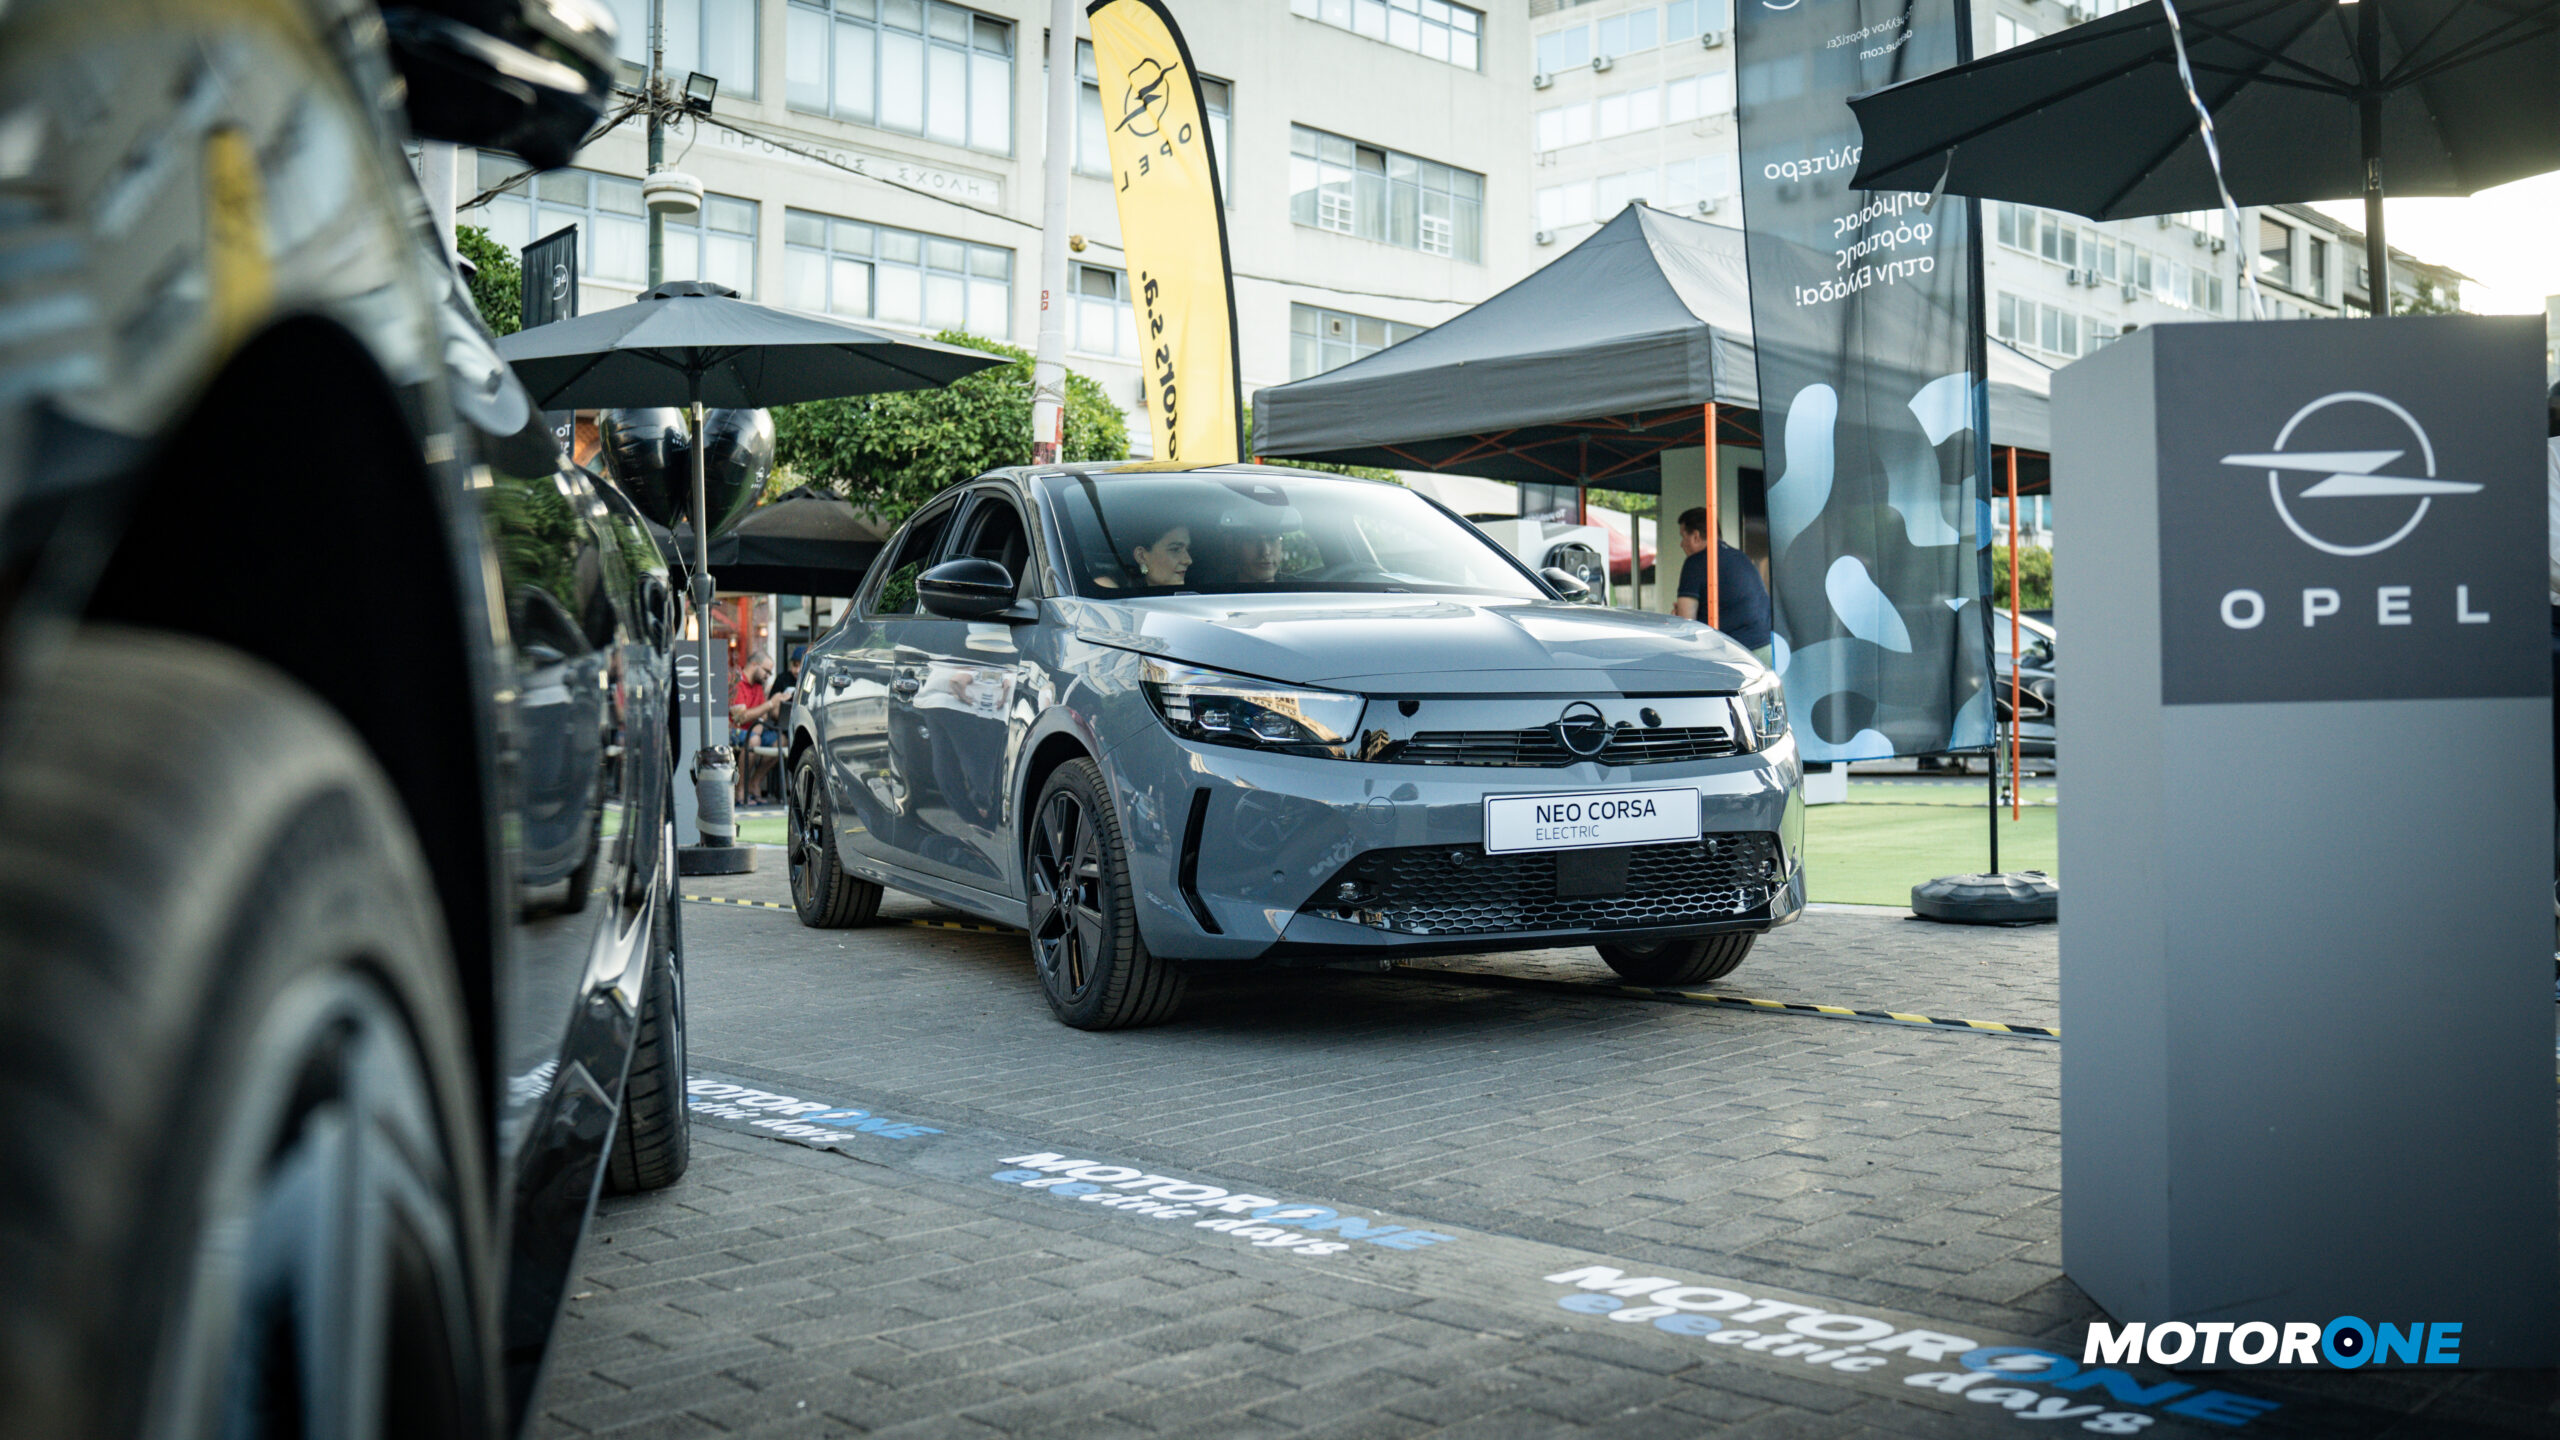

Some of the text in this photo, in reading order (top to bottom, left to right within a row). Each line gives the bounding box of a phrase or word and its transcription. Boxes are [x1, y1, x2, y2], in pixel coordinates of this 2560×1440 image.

[899, 165, 982, 197] ΣΧΟΛΗ
[2219, 584, 2491, 630] OPEL
[678, 693, 717, 703] PEL
[1536, 799, 1657, 823] NEO CORSA
[1536, 824, 1600, 841] ELECTRIC
[750, 1117, 857, 1143] days
[990, 1168, 1350, 1256] electric days
[997, 1151, 1457, 1251] MOTORONE
[1544, 1264, 2283, 1428] MOTORONE
[1557, 1292, 2157, 1436] electric days
